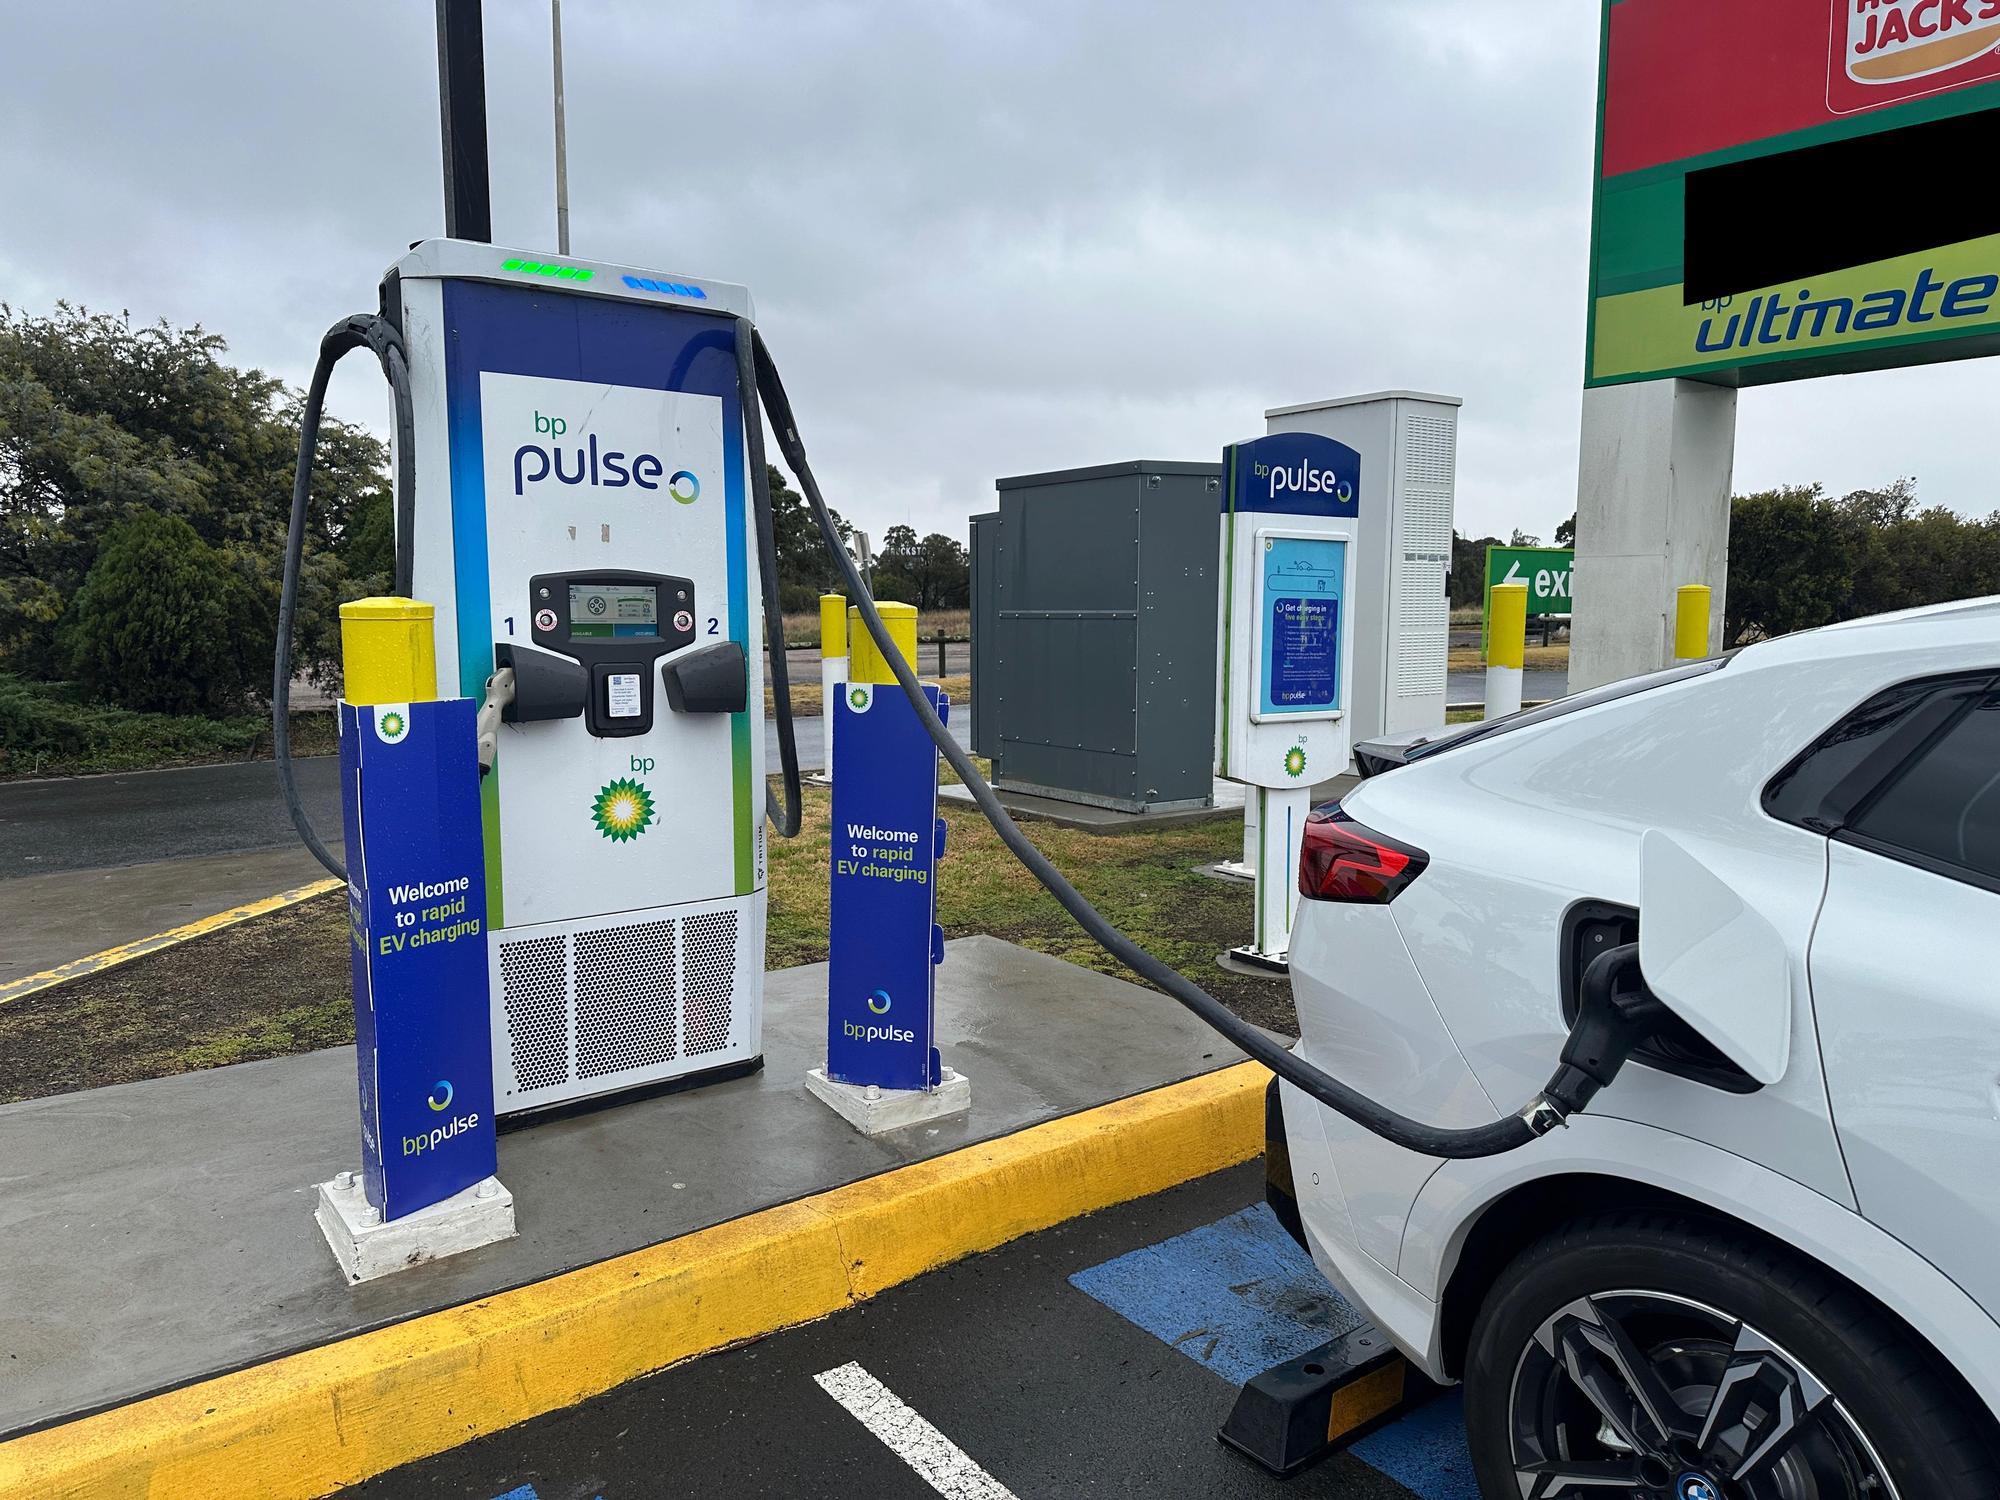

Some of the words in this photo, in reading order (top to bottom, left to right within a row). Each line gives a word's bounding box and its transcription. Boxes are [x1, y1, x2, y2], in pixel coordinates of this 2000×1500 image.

[1695, 268, 1999, 353] ultimate
[534, 410, 567, 439] bp
[514, 433, 663, 496] pulse
[1254, 460, 1269, 479] bp
[1270, 458, 1336, 498] pulse
[887, 546, 931, 556] TRUCKSTO
[1535, 561, 1575, 598] exi
[1285, 604, 1296, 612] Get
[504, 617, 515, 636] 1
[707, 618, 719, 635] 2
[1298, 734, 1308, 745] bp
[630, 754, 655, 775] bp
[847, 823, 919, 843] Welcome
[851, 844, 868, 858] to
[873, 847, 913, 863] rapid
[837, 860, 859, 876] EV
[862, 863, 928, 884] charging
[388, 876, 470, 905] Welcome
[395, 911, 416, 928] to
[421, 896, 465, 923] rapid
[379, 934, 406, 956] EV
[410, 918, 480, 948] charging
